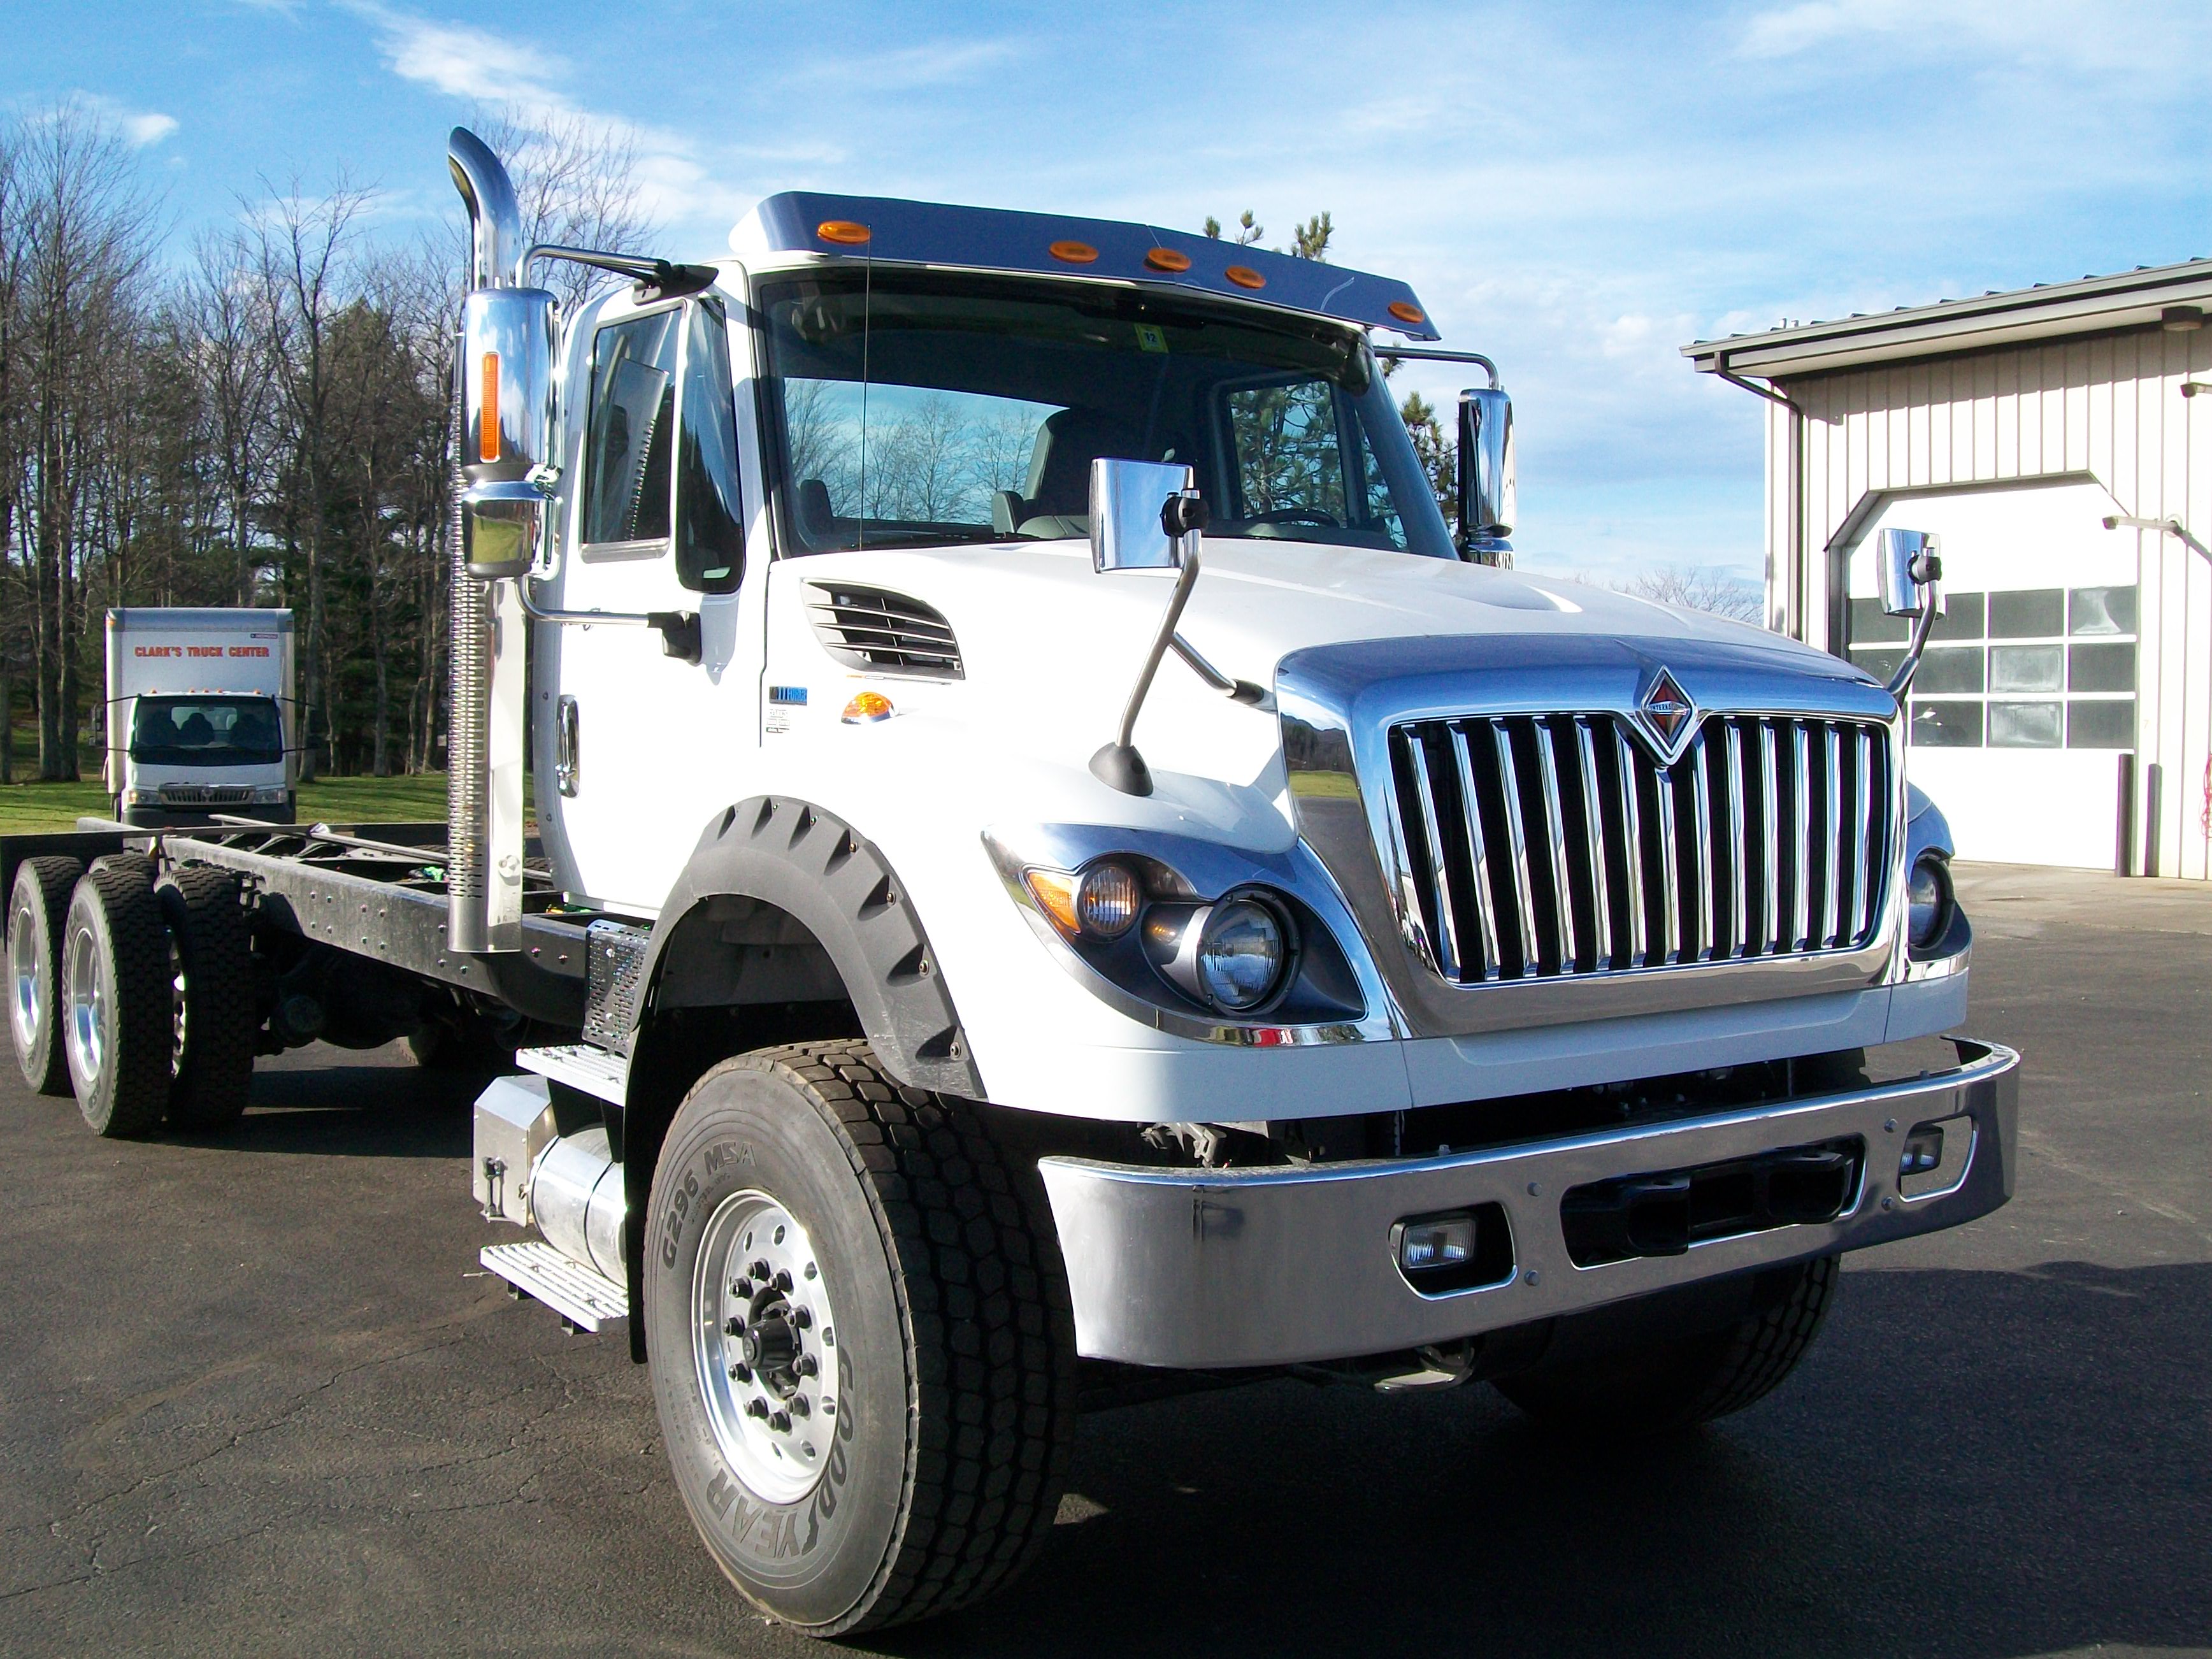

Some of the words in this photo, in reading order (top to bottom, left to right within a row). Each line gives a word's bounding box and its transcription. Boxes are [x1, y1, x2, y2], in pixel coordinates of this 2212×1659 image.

[134, 646, 182, 657] CLARK'S
[187, 646, 223, 657] TRUCK
[228, 646, 269, 657] CENTER
[663, 1168, 700, 1270] G296
[703, 1140, 758, 1176] MSA
